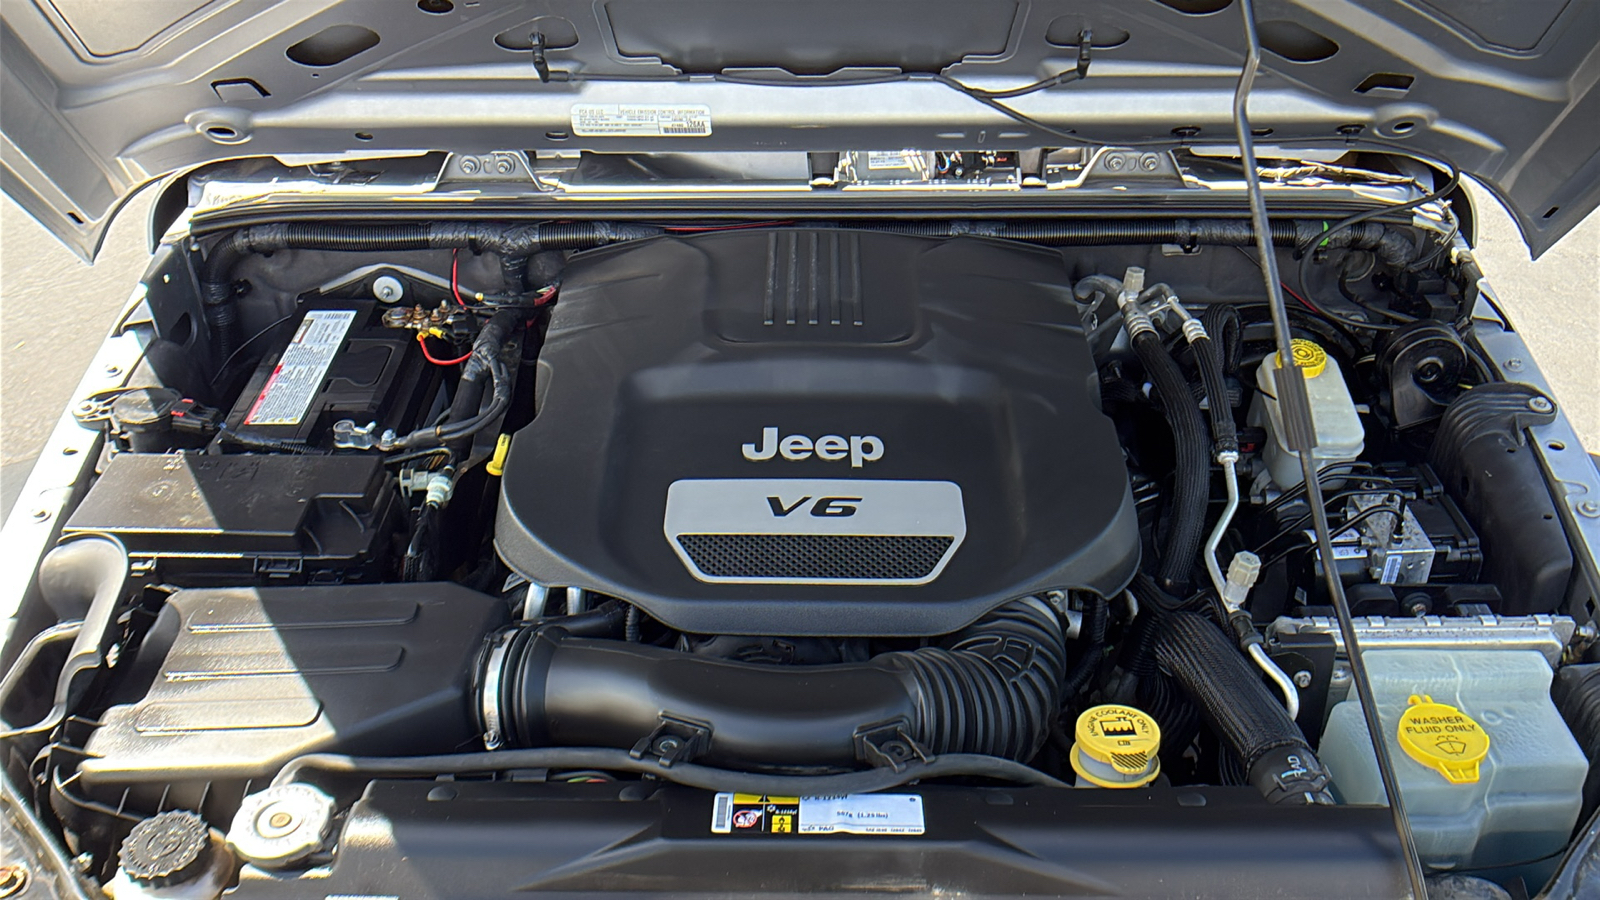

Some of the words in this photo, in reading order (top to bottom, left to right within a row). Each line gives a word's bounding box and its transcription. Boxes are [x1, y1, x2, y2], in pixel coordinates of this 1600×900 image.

[742, 427, 885, 468] Jeep
[766, 496, 863, 518] V6
[1096, 709, 1138, 719] COOLANT
[1136, 718, 1149, 734] ONLY
[1405, 725, 1442, 734] FLUID
[1444, 724, 1476, 733] ONLY
[1409, 716, 1464, 725] WASHER
